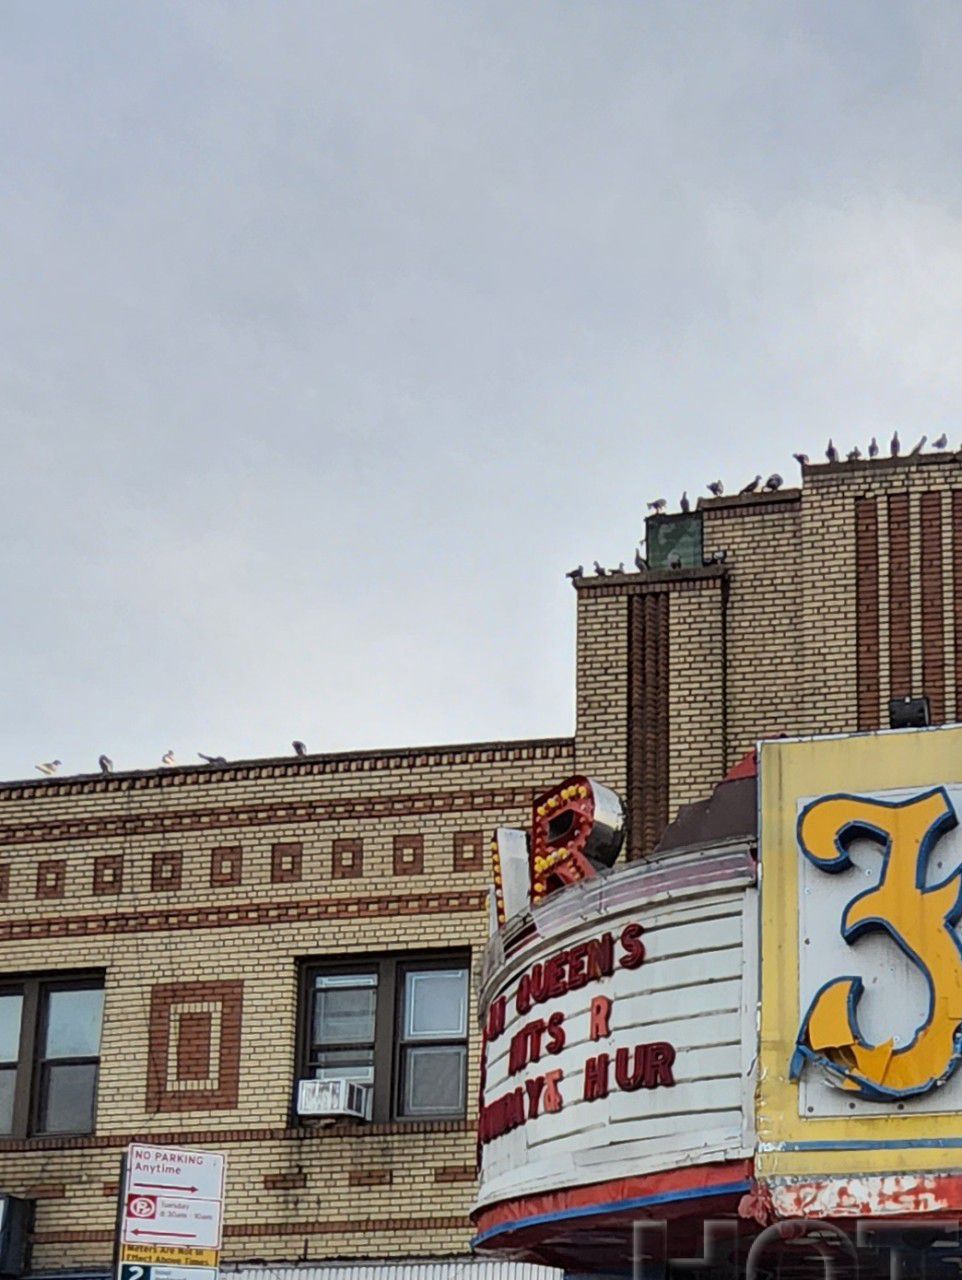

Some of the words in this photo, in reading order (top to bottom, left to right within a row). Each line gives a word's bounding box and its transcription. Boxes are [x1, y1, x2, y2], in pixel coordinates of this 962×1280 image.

[516, 923, 646, 1015] QUEENS
[135, 1150, 151, 1161] NO
[154, 1152, 204, 1166] PARKING
[134, 1162, 182, 1175] Anytime
[126, 1253, 153, 1262] Effect
[155, 1255, 182, 1264] Above
